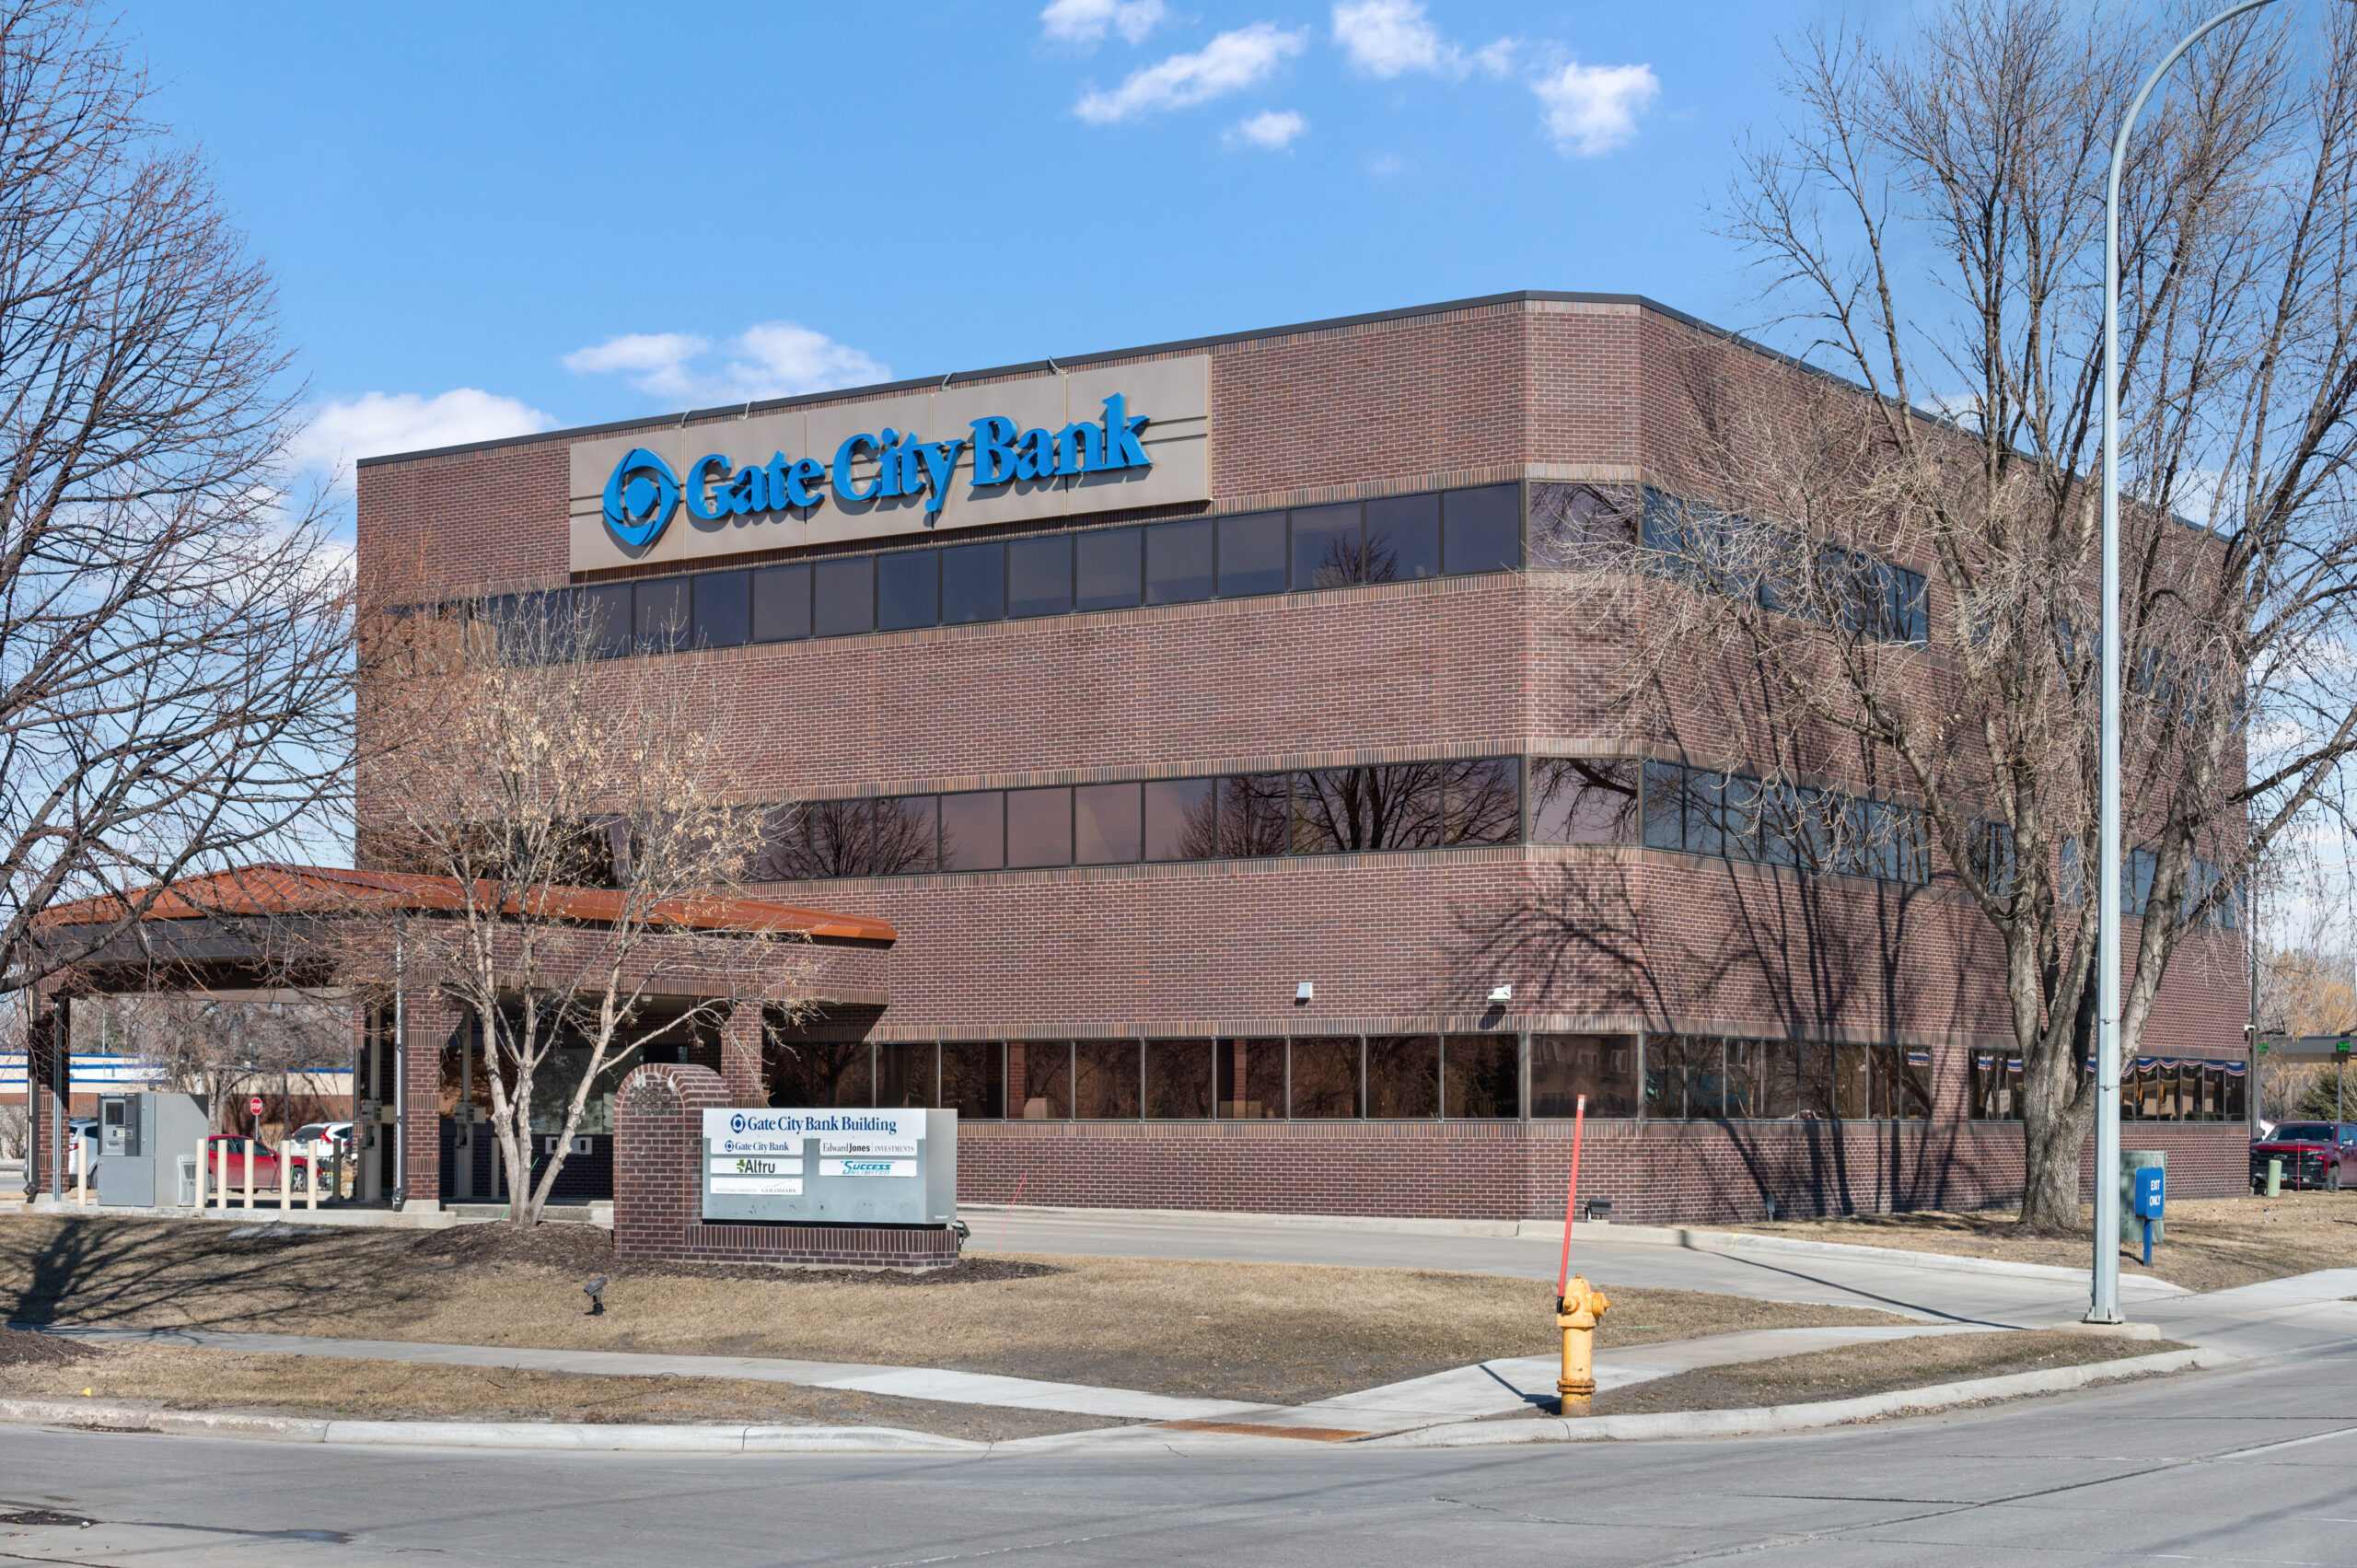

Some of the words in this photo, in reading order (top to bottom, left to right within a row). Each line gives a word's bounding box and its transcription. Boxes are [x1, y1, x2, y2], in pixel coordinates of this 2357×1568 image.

[685, 450, 826, 521] Gate
[831, 427, 967, 513] City
[969, 392, 1155, 487] Bank
[631, 1086, 673, 1104] 2850
[748, 1116, 776, 1132] Gate
[778, 1116, 804, 1134] City
[805, 1116, 839, 1132] Bank
[842, 1116, 897, 1135] Building
[735, 1142, 752, 1151] Gate
[753, 1142, 769, 1153] City
[769, 1142, 789, 1151] Bank
[823, 1143, 848, 1152] Edward
[849, 1143, 870, 1153] Jones
[745, 1159, 775, 1174] Altru
[843, 1160, 891, 1170] SUCCESS
[2150, 1179, 2161, 1191] EXIT
[2149, 1195, 2161, 1206] ONLY
